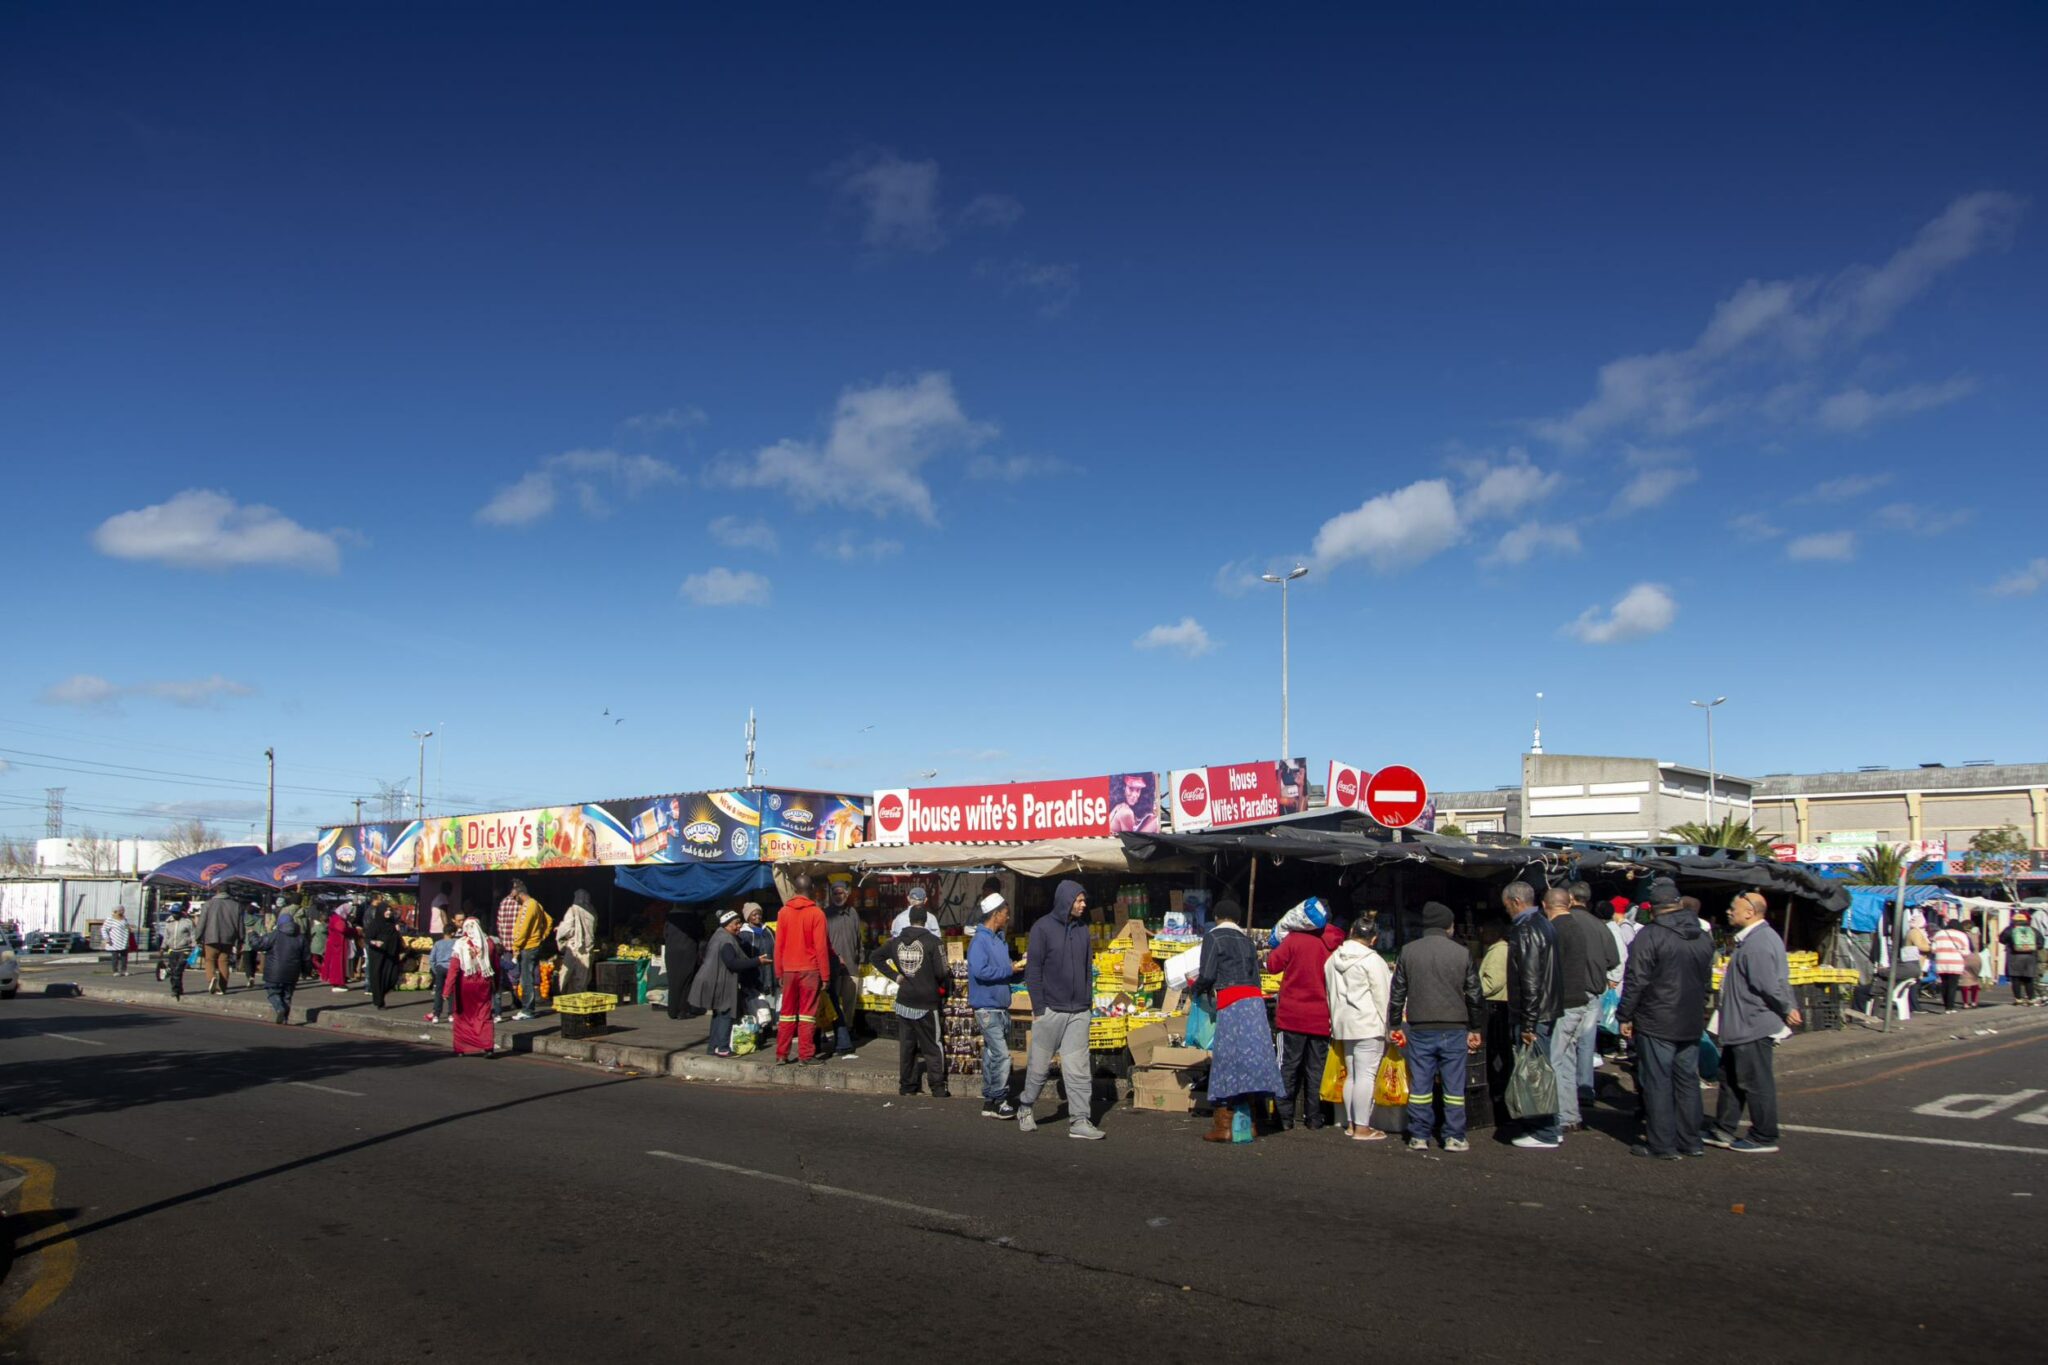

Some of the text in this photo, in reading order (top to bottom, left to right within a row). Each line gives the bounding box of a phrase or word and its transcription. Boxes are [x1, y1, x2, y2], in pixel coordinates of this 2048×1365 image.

[1228, 768, 1258, 791] House
[1181, 787, 1205, 802] Coca-Cola
[909, 789, 1108, 833] House wife's Paradise
[1211, 793, 1278, 823] Wife's Paradise
[467, 816, 532, 856] Dicky's
[770, 839, 806, 854] Dicky's
